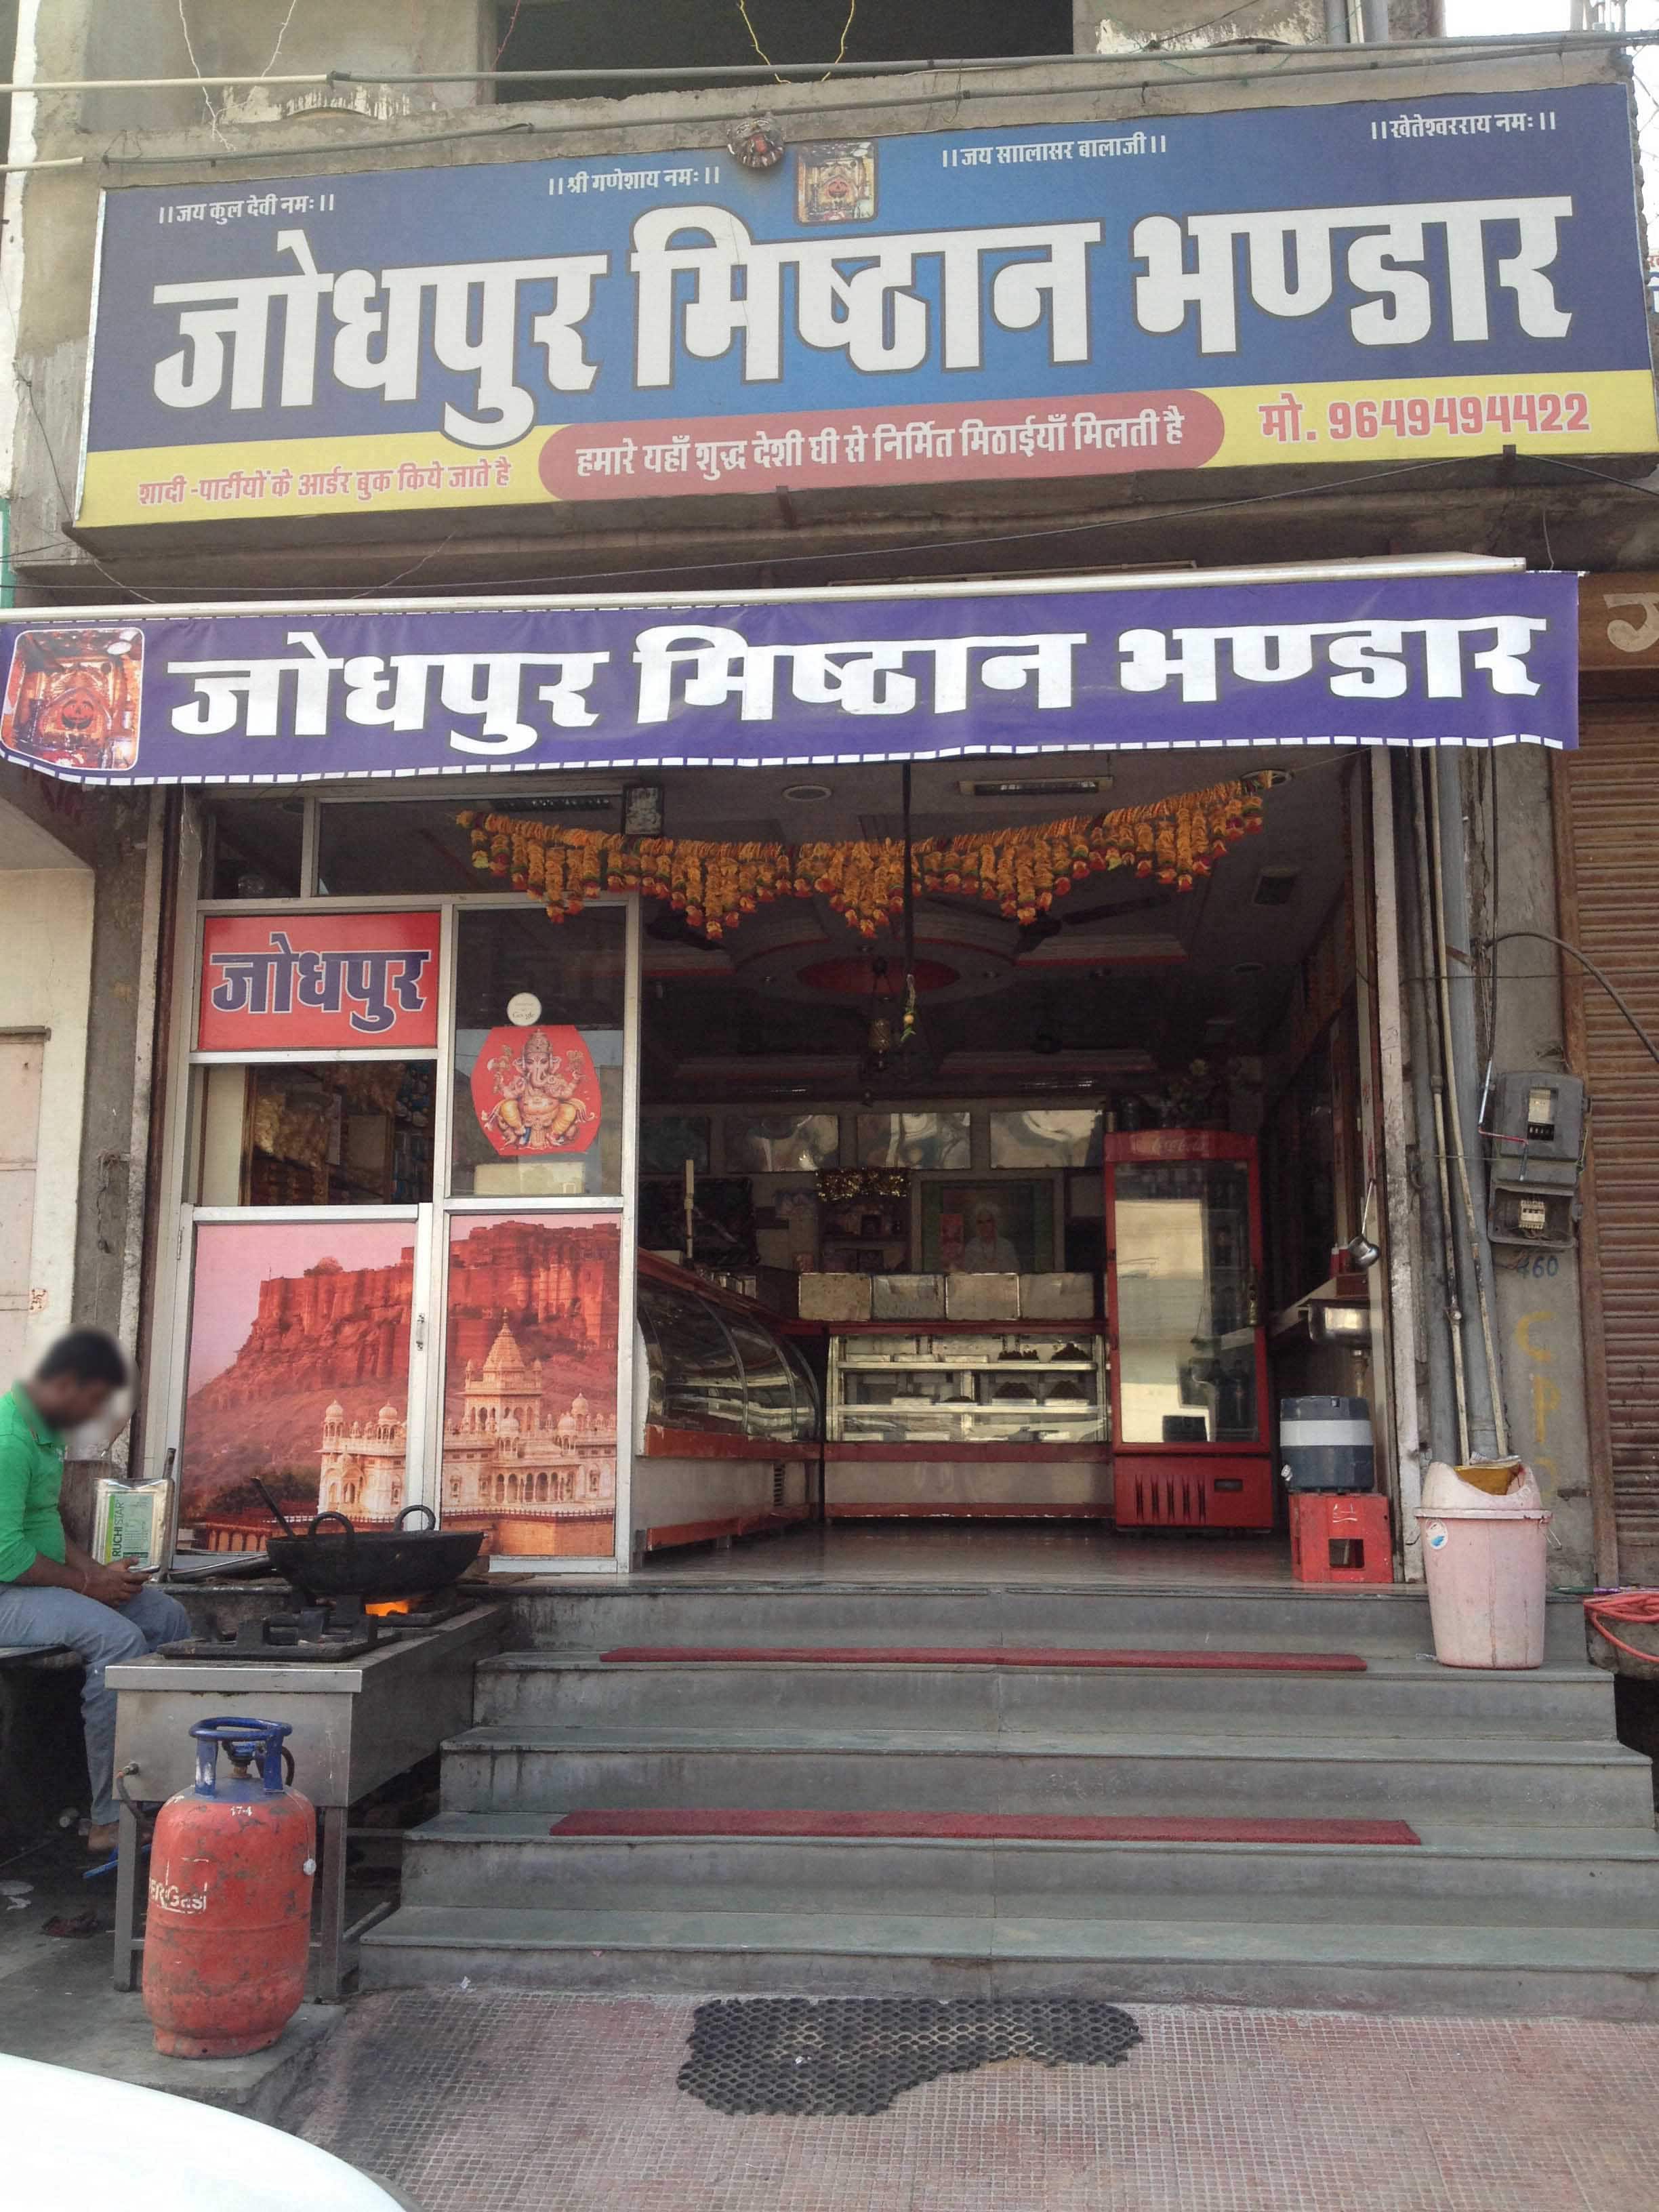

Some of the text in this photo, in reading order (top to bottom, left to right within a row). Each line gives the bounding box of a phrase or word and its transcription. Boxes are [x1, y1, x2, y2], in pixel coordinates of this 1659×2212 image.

[591, 168, 661, 192] गणेशाय
[209, 201, 244, 225] कुल
[246, 194, 277, 216] देवी
[153, 229, 608, 446] जोधपुर
[1133, 196, 1572, 354] भण्डार
[1258, 393, 1589, 441] मो. 9649494422
[576, 406, 1185, 481] हमारे यहाँ शुद्ध देशी घी से निर्मित मिठाईयाँ मिलती है
[140, 475, 187, 504] शादी
[272, 469, 293, 496] के
[298, 466, 352, 495] आर्डर
[356, 470, 394, 500] बुक
[398, 461, 444, 491] किये
[448, 459, 491, 487] जाते
[495, 456, 511, 486] है
[167, 632, 609, 755] जोधपुर
[1119, 615, 1547, 702] भण्डार
[210, 932, 431, 1032] जोधपुर
[112, 1527, 123, 1557] RUCHI
